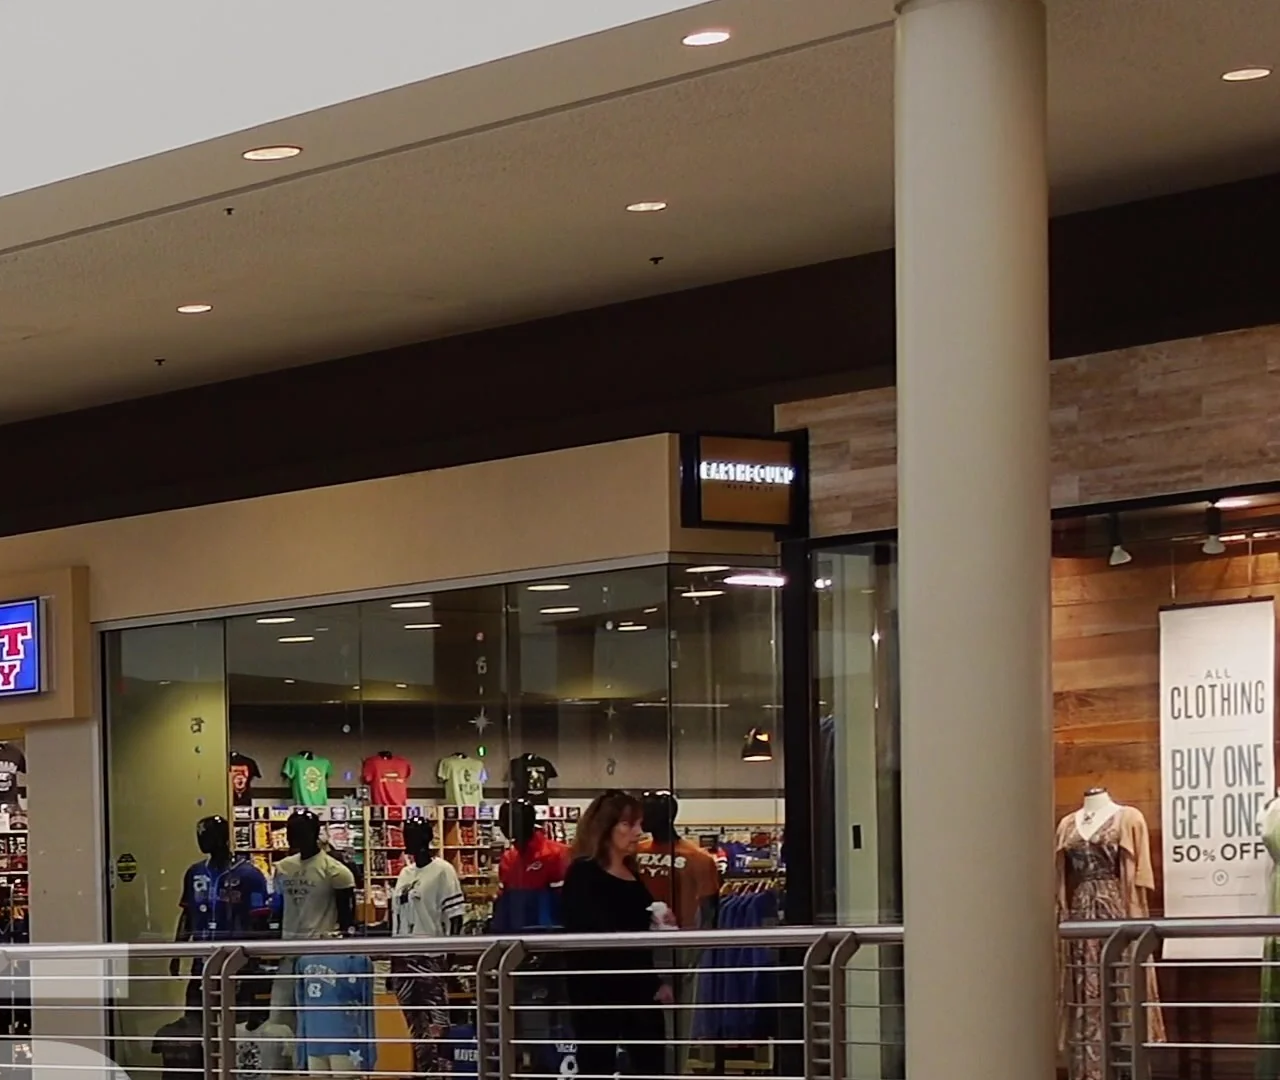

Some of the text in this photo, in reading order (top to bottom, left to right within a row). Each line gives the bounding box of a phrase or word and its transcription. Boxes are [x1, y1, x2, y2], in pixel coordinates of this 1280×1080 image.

[1204, 668, 1231, 680] ALL
[1170, 680, 1265, 720] CLOTHING
[1171, 743, 1265, 791] BUY ONE
[1172, 792, 1264, 840] GET ONE
[1172, 842, 1265, 863] 50% OFF
